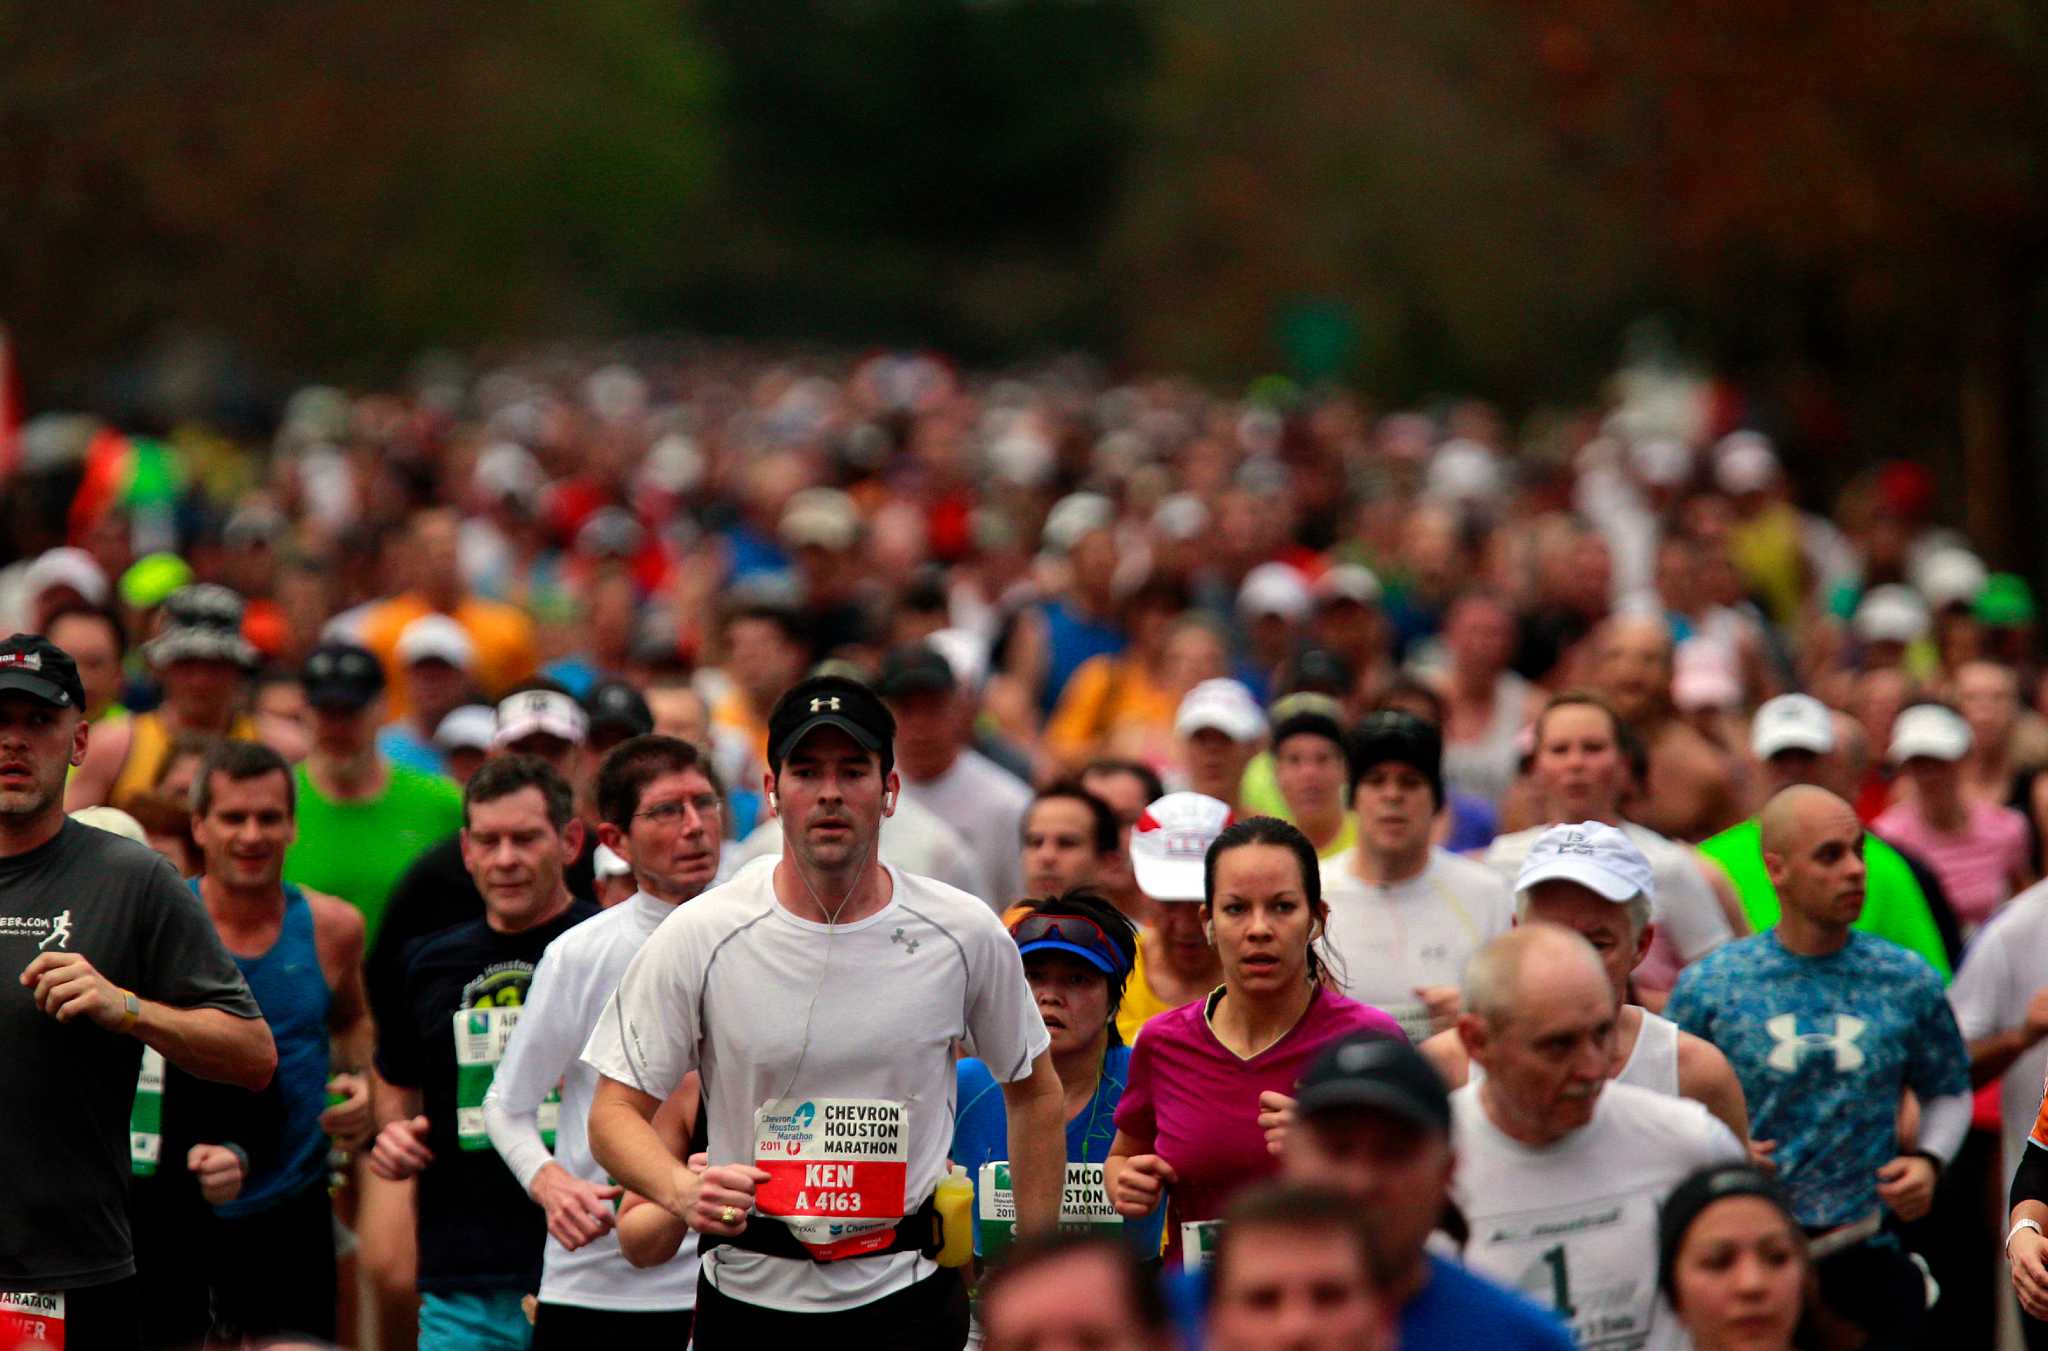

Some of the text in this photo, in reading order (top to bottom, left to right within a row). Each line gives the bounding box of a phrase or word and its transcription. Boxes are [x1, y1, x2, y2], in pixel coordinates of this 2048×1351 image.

[761, 1114, 792, 1122] Chevron
[825, 1106, 899, 1121] CHEVRON
[769, 1123, 800, 1131] Houston
[825, 1122, 898, 1138] HOUSTON
[777, 1132, 813, 1141] Marathon
[760, 1141, 781, 1151] 2011
[824, 1141, 897, 1155] MARATHON
[805, 1164, 855, 1188] KEN
[1067, 1169, 1103, 1185] MCO
[795, 1192, 861, 1212] A 4163
[1064, 1189, 1103, 1203] STON
[996, 1208, 1015, 1218] 2011
